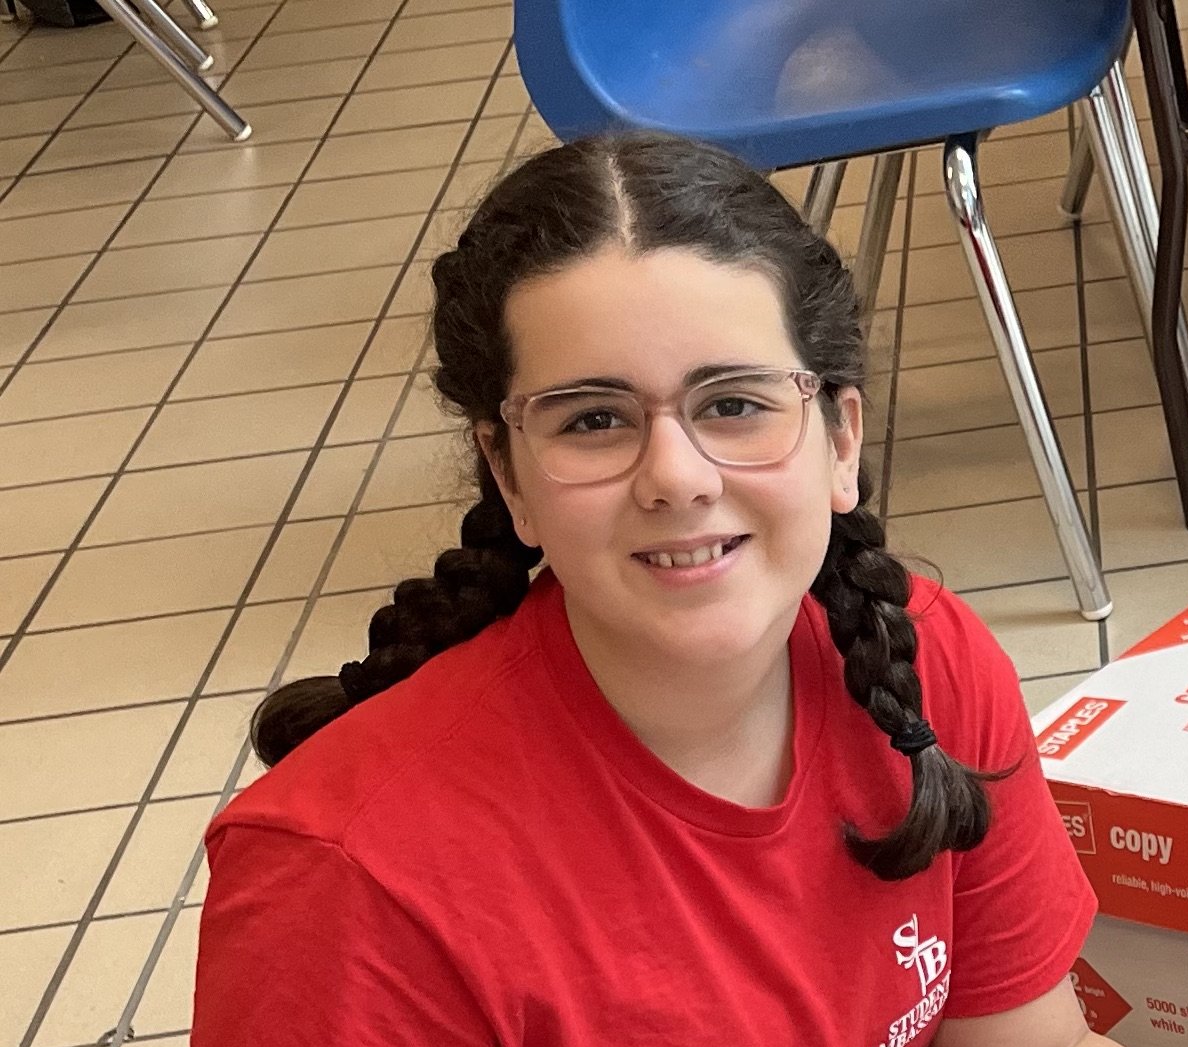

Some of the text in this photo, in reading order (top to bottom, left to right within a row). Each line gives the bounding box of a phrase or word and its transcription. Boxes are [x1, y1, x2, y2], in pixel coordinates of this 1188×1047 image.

[1038, 700, 1108, 754] STAPLES
[1110, 826, 1173, 864] copy
[1112, 874, 1149, 892] reliable,
[889, 970, 951, 1038] STUDENT
[1146, 998, 1176, 1015] 5000
[1150, 1018, 1184, 1034] white
